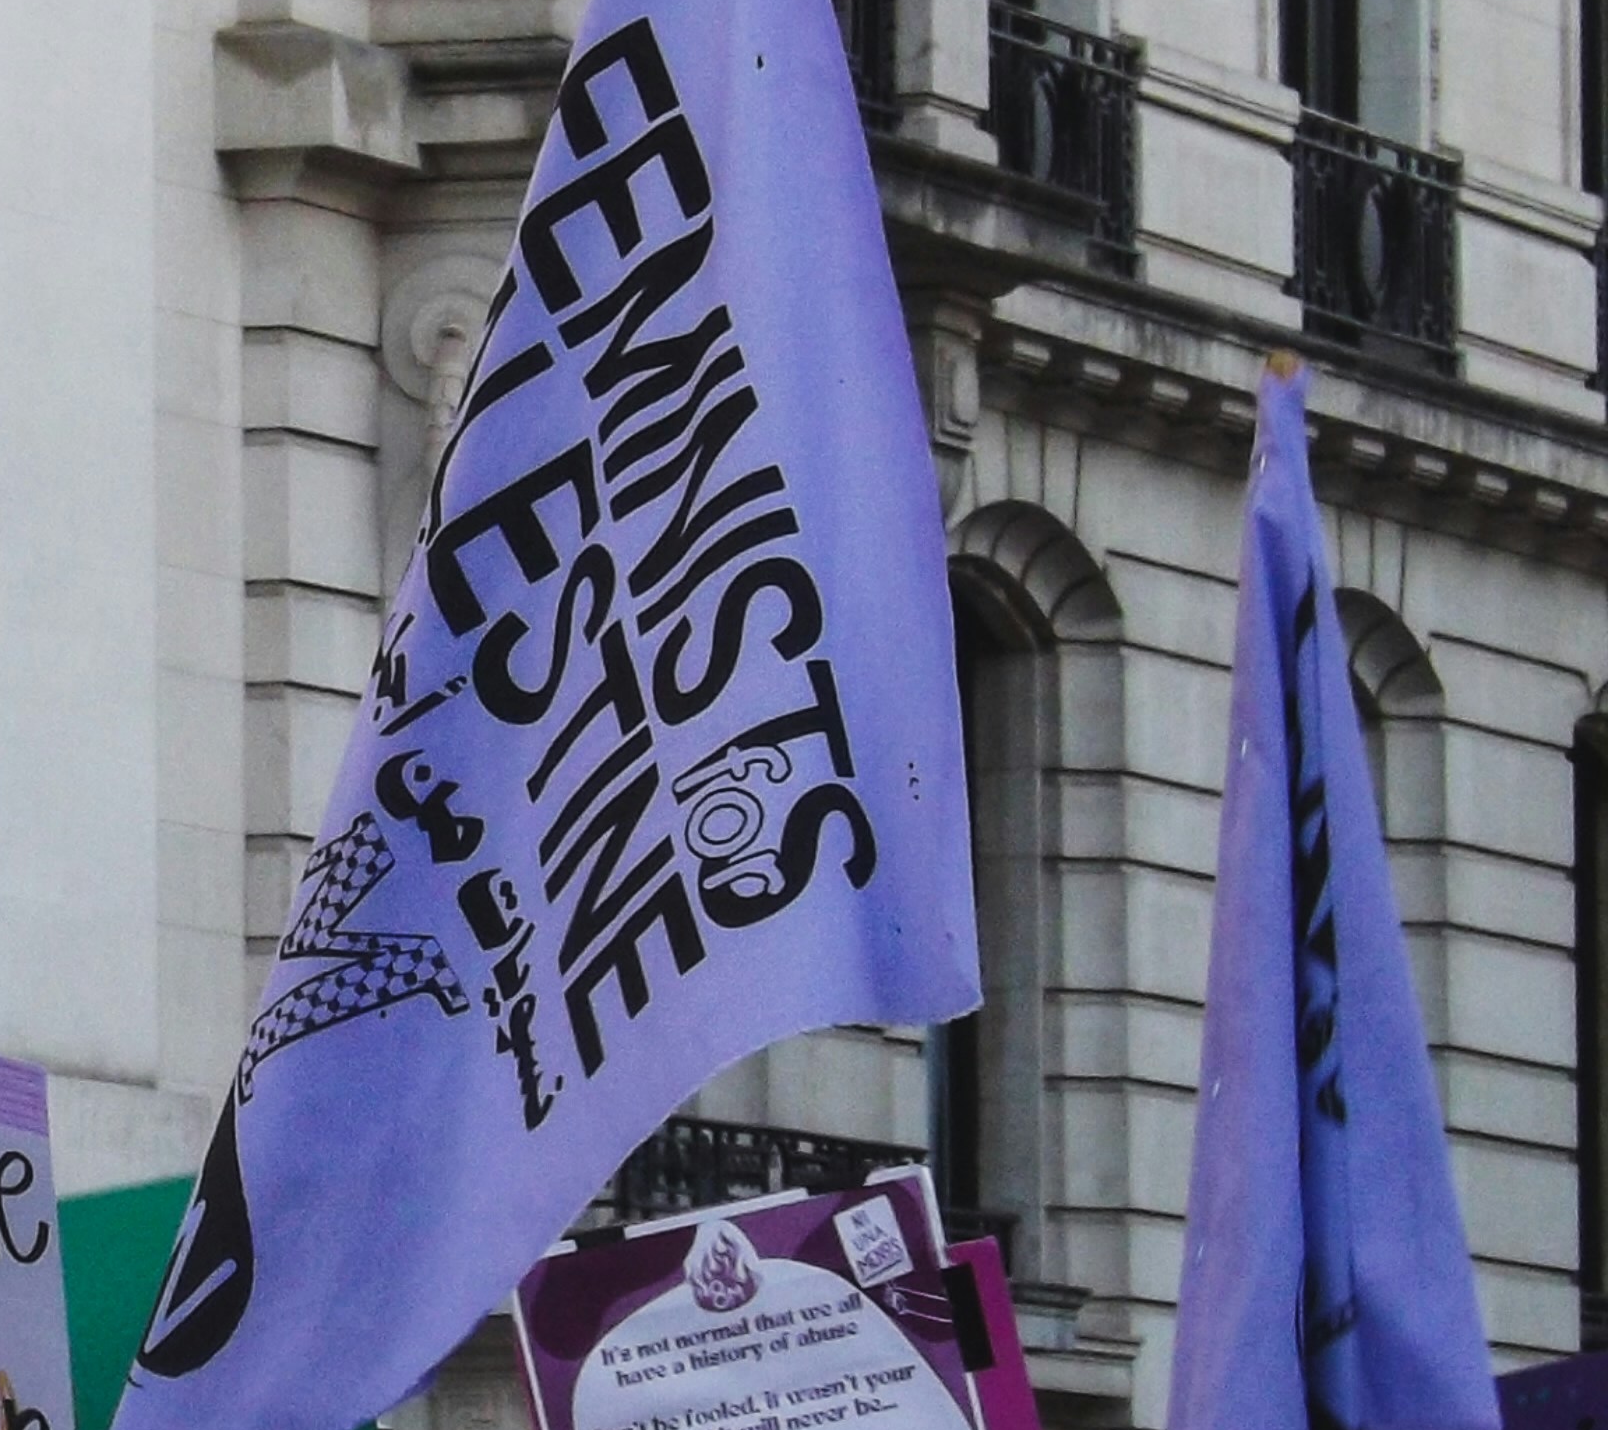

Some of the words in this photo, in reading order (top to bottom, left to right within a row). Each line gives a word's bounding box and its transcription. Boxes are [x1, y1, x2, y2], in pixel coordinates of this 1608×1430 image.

[520, 18, 877, 928] FEMINISTS
[424, 271, 707, 1078] LESTINE
[672, 745, 791, 899] for
[602, 1348, 631, 1366] It's
[638, 1337, 670, 1359] not
[676, 1317, 750, 1349] normal
[754, 1310, 792, 1332] that
[801, 1302, 832, 1321] we
[838, 1293, 863, 1313] all
[616, 1366, 666, 1387] have
[673, 1360, 685, 1376] a
[690, 1342, 764, 1371] history
[770, 1332, 791, 1353] of
[797, 1322, 858, 1347] abuse
[764, 1390, 779, 1410] it
[787, 1373, 859, 1405] wasn't
[864, 1365, 916, 1393] your
